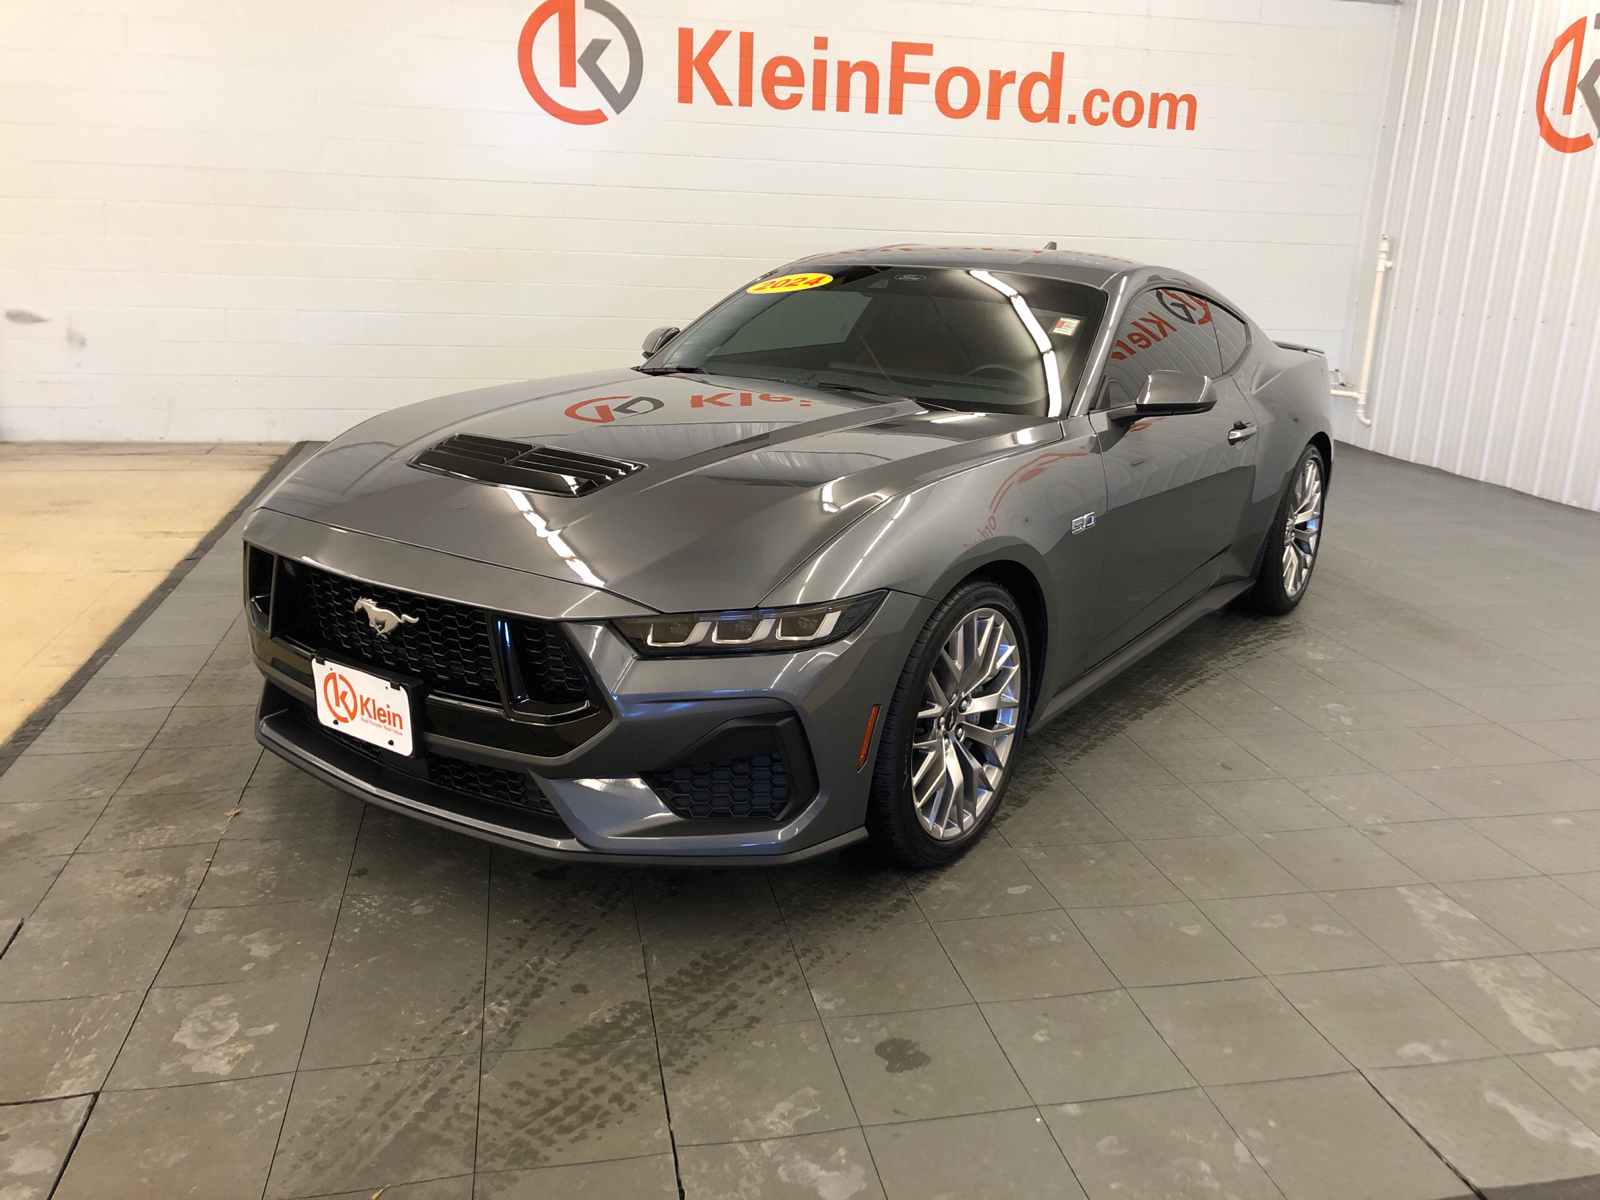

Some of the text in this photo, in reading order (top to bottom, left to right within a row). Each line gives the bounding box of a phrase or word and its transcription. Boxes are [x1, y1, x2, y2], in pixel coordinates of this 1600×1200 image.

[677, 27, 1198, 131] KleinFord.com
[752, 276, 827, 292] 2024
[359, 694, 404, 729] Klein
